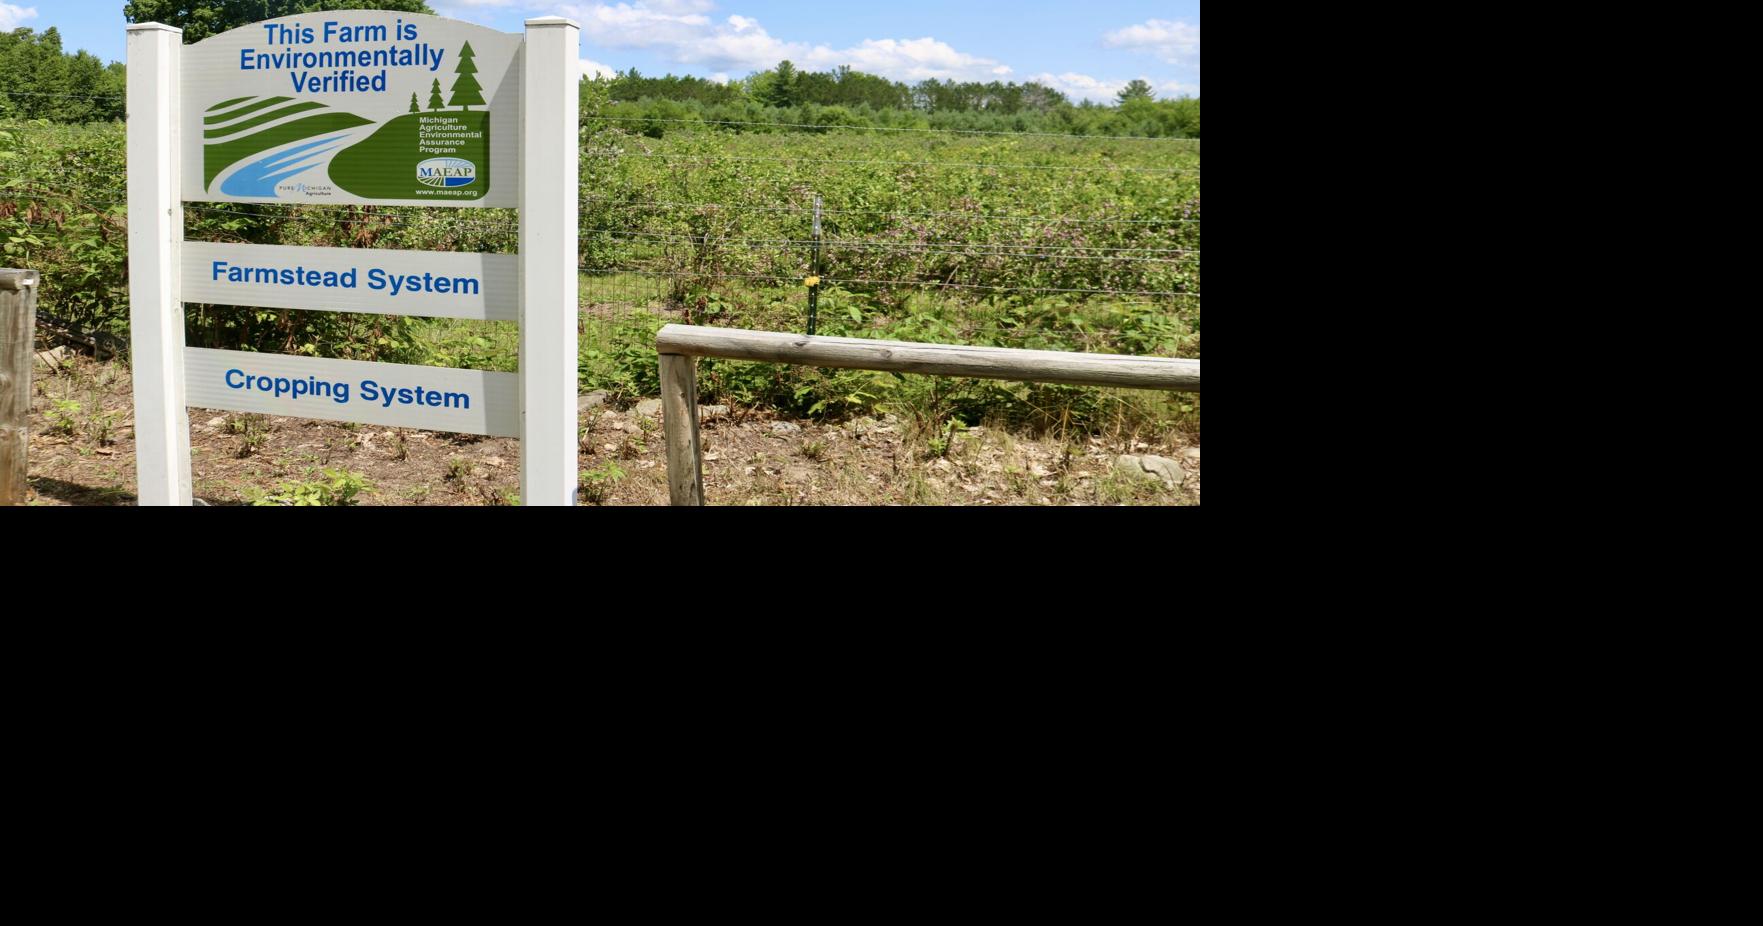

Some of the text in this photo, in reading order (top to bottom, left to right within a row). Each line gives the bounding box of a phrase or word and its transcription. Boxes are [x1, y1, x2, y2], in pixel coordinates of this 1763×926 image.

[264, 19, 418, 45] This Farm is
[240, 43, 444, 72] Environmentally
[290, 69, 387, 93] Verified
[419, 124, 467, 132] Agriculture
[419, 146, 456, 154] Program
[420, 168, 472, 176] MAEAP
[212, 260, 480, 296] Farmstead System
[224, 368, 470, 409] Cropping System
